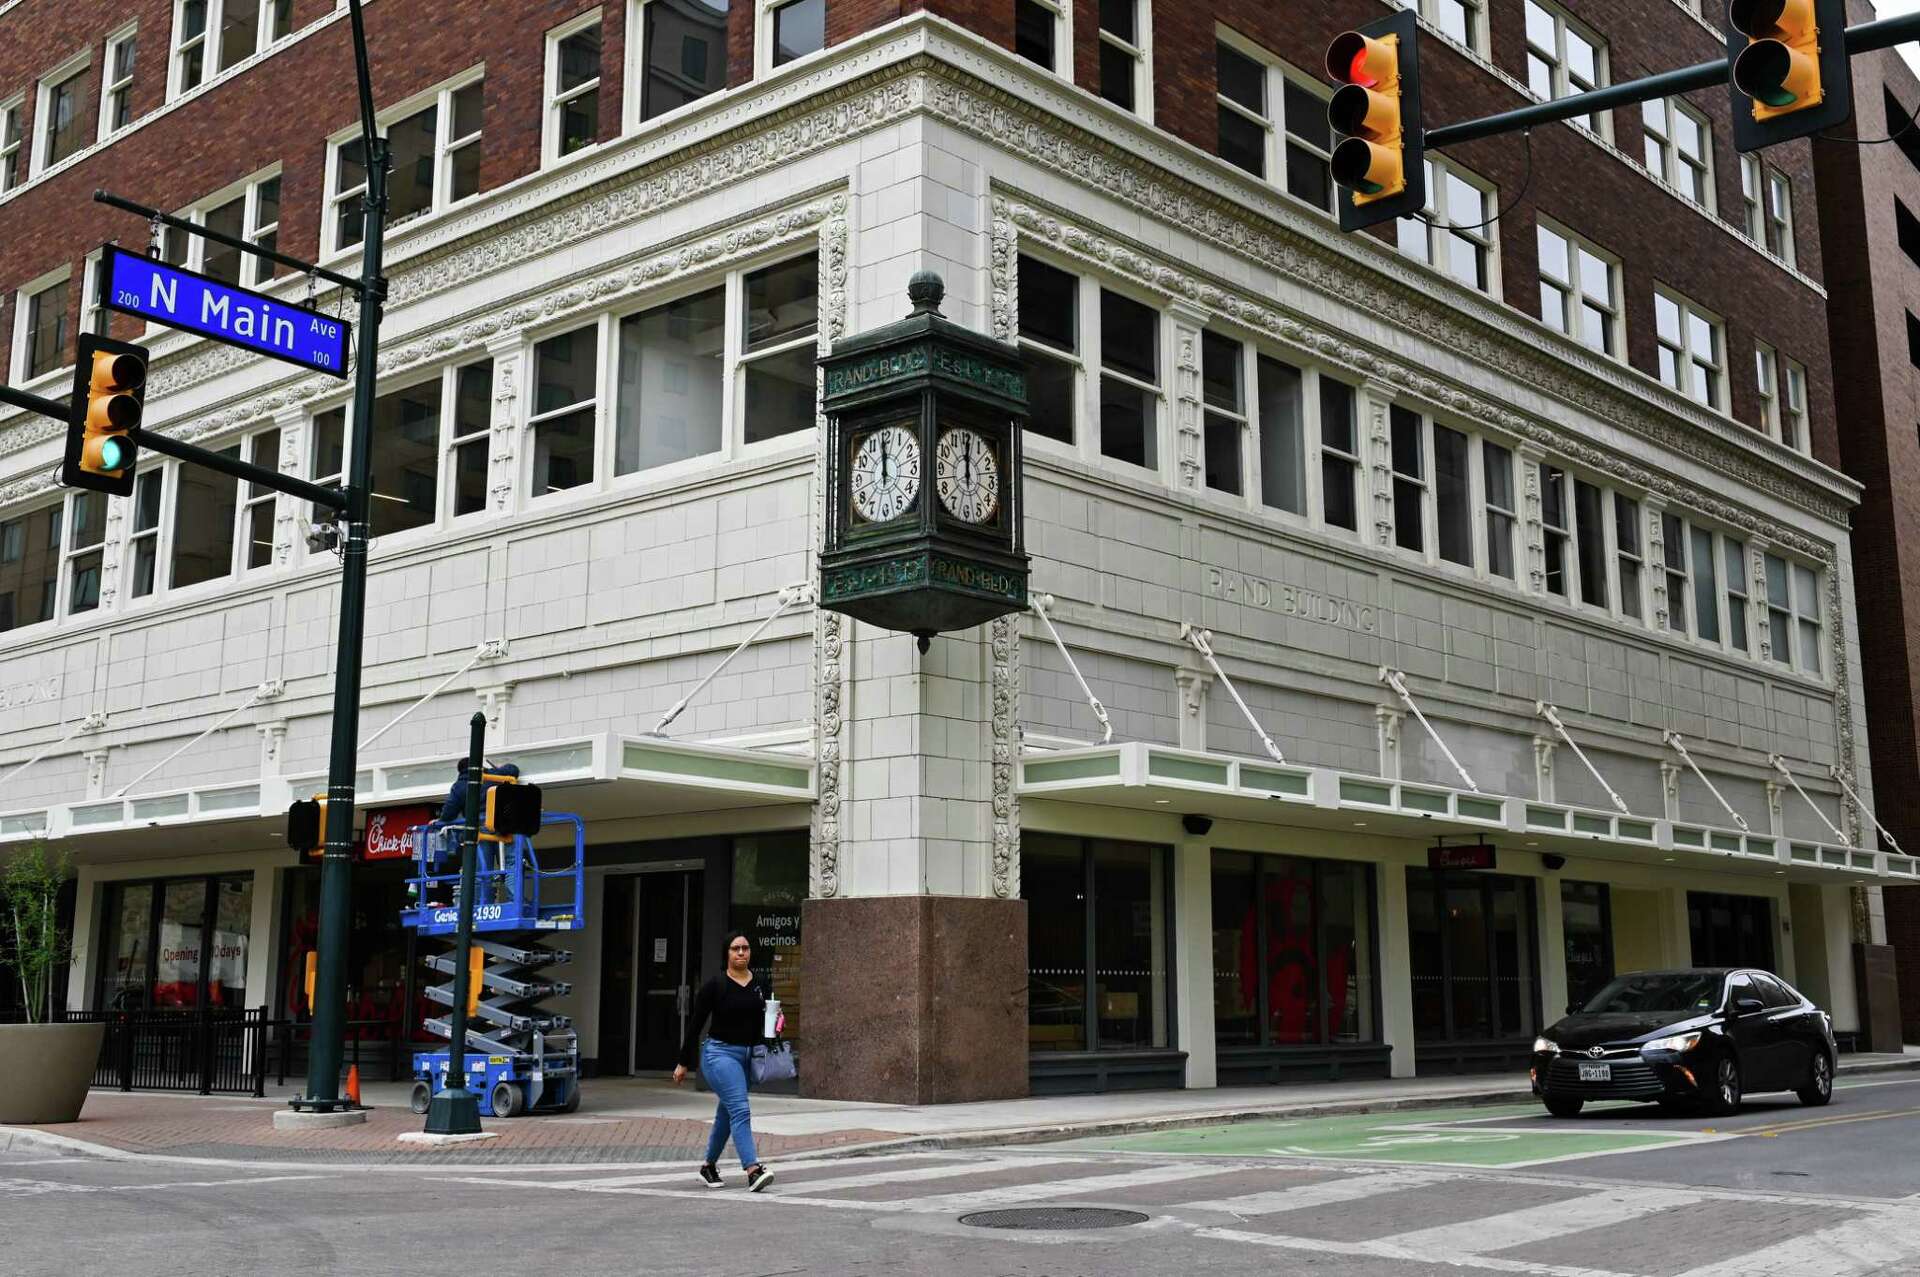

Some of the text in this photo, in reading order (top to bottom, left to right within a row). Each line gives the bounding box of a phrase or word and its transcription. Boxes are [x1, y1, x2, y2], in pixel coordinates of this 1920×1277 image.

[118, 290, 139, 308] 200
[150, 272, 295, 350] N Main
[310, 318, 337, 339] Ave
[313, 350, 330, 365] 100
[882, 431, 891, 444] 12
[898, 433, 901, 446] 1
[951, 433, 958, 448] 11
[962, 432, 971, 445] 12
[870, 439, 876, 453] 11
[906, 444, 913, 459] 2
[940, 443, 950, 458] 10
[977, 441, 980, 454] 1
[858, 455, 868, 469] 10
[910, 460, 918, 475] 3
[938, 462, 945, 476] 9
[985, 457, 991, 471] 2
[856, 474, 862, 488] 9
[904, 480, 913, 494] 4
[942, 481, 948, 495] 8
[988, 475, 995, 490] 3
[859, 491, 866, 504] 8
[896, 495, 903, 510] 5
[951, 496, 957, 510] 7
[984, 493, 991, 507] 4
[869, 501, 875, 515] 7
[882, 503, 889, 517] 6
[963, 504, 969, 518] 6
[976, 503, 982, 517] 5
[1283, 587, 1374, 631] BUILDING
[434, 909, 458, 923] Genie
[756, 914, 800, 930] Amigos y
[758, 933, 797, 947] vecinos
[163, 946, 199, 963] Opening
[220, 944, 241, 960] days
